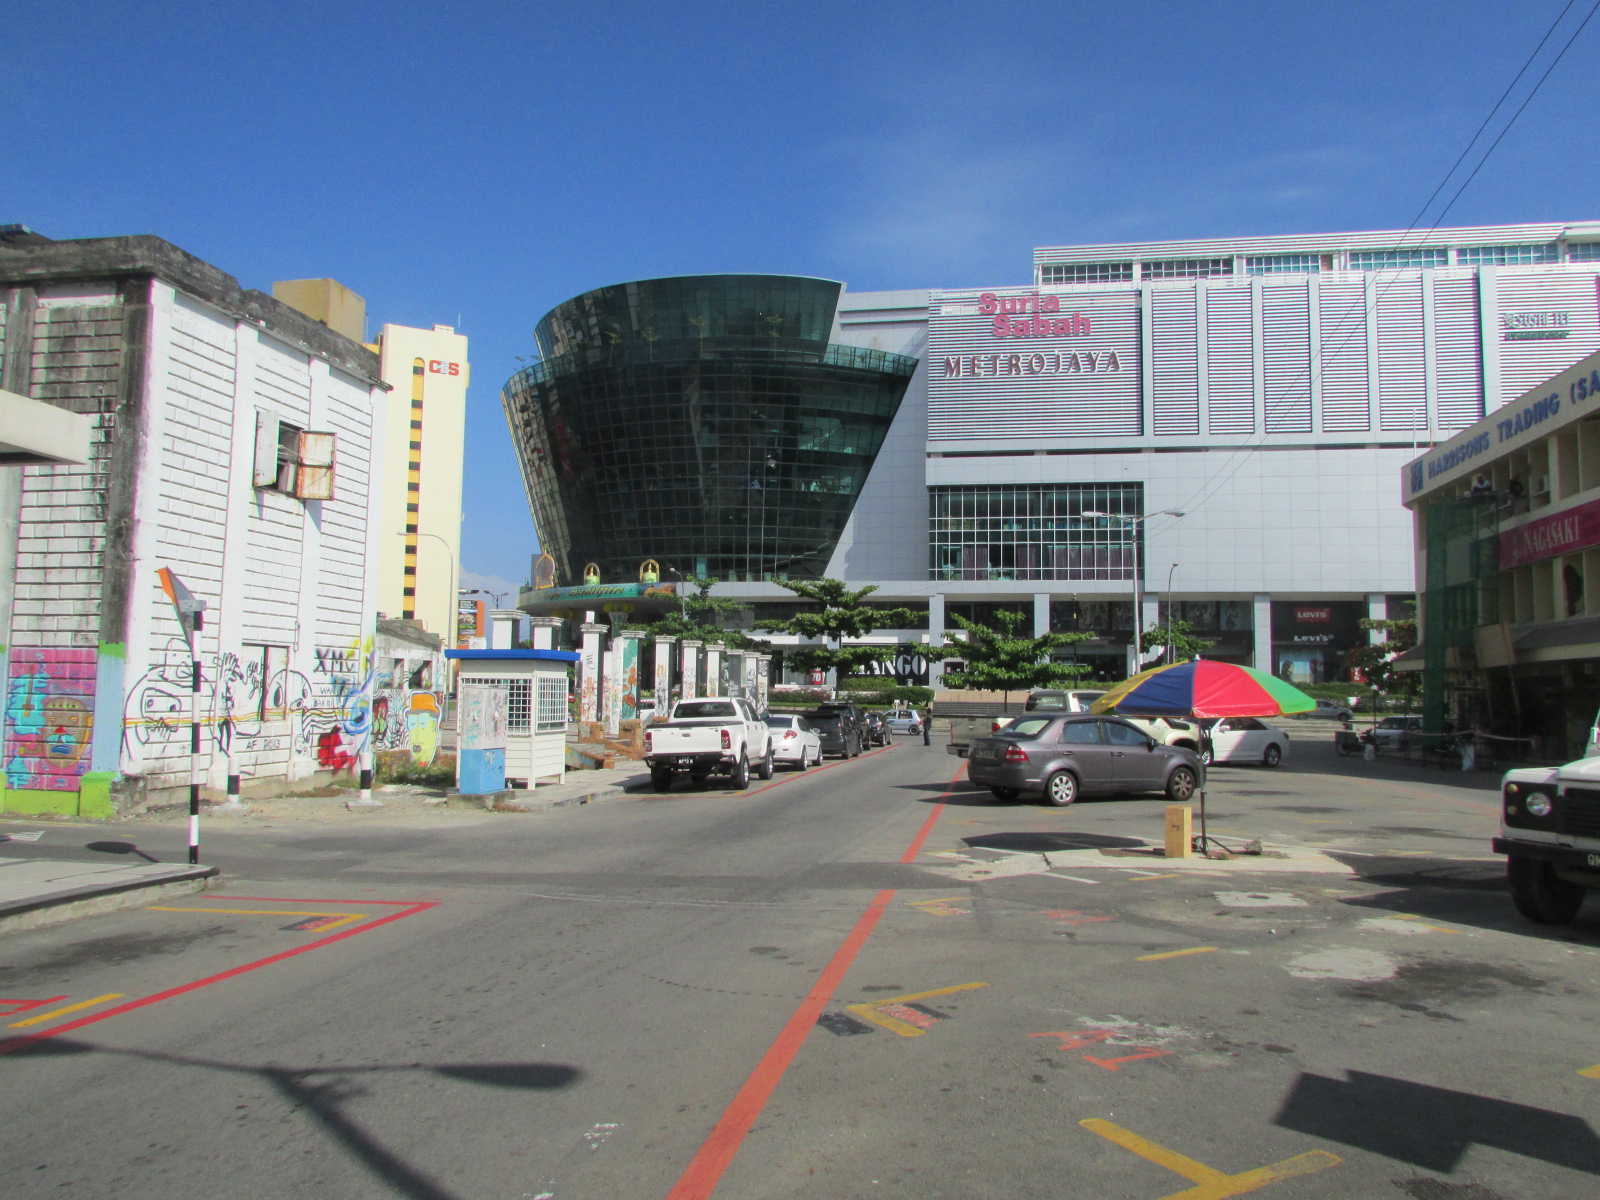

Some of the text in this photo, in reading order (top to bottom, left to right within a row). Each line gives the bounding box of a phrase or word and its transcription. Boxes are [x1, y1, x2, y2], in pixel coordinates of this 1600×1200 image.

[978, 291, 1061, 315] Suria
[992, 313, 1092, 338] Sabah
[944, 349, 1122, 378] METROJAYA
[1428, 431, 1490, 479] HARRISONS
[1496, 392, 1561, 443] TRADING
[1522, 515, 1580, 556] NAGASAKI
[263, 739, 282, 750] 2013
